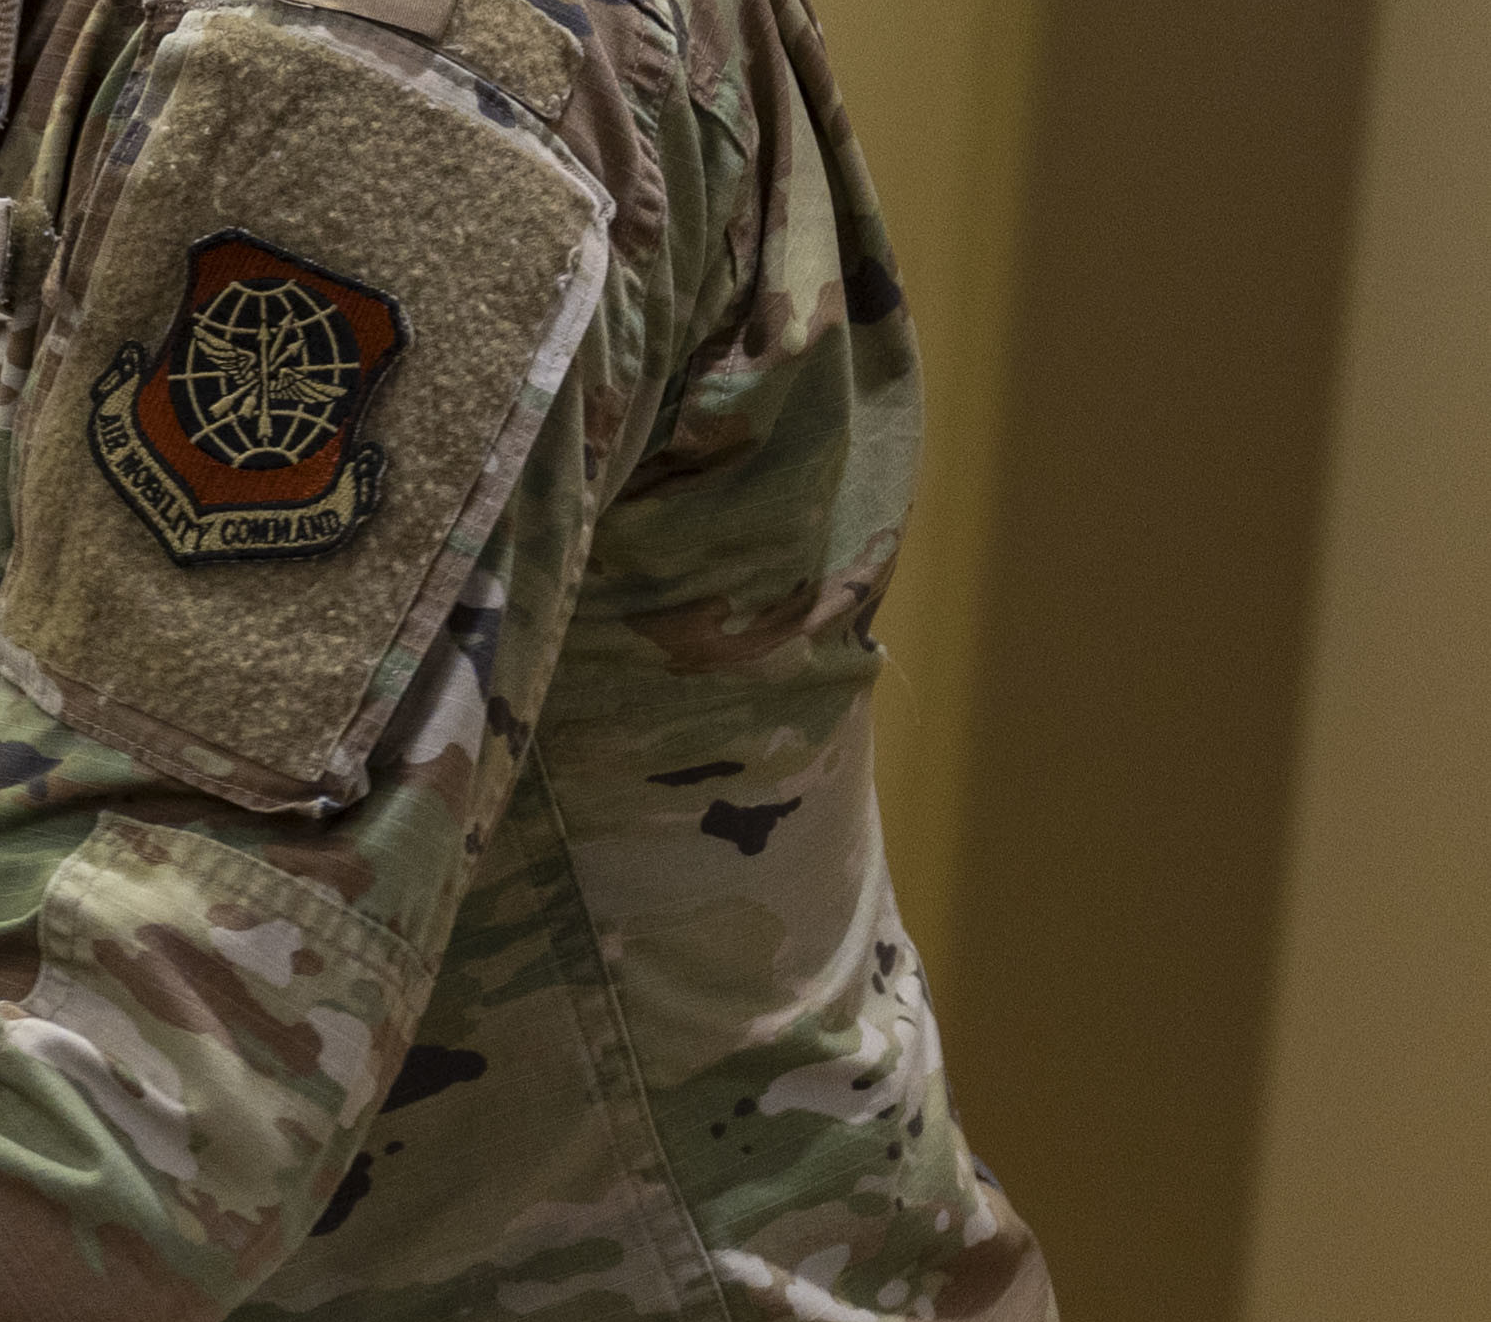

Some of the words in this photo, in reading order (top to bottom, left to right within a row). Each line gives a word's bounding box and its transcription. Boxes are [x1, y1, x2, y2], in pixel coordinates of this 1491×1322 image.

[98, 413, 129, 455] AIR
[115, 450, 210, 550] MOBILITY
[220, 509, 341, 545] COMMAND
